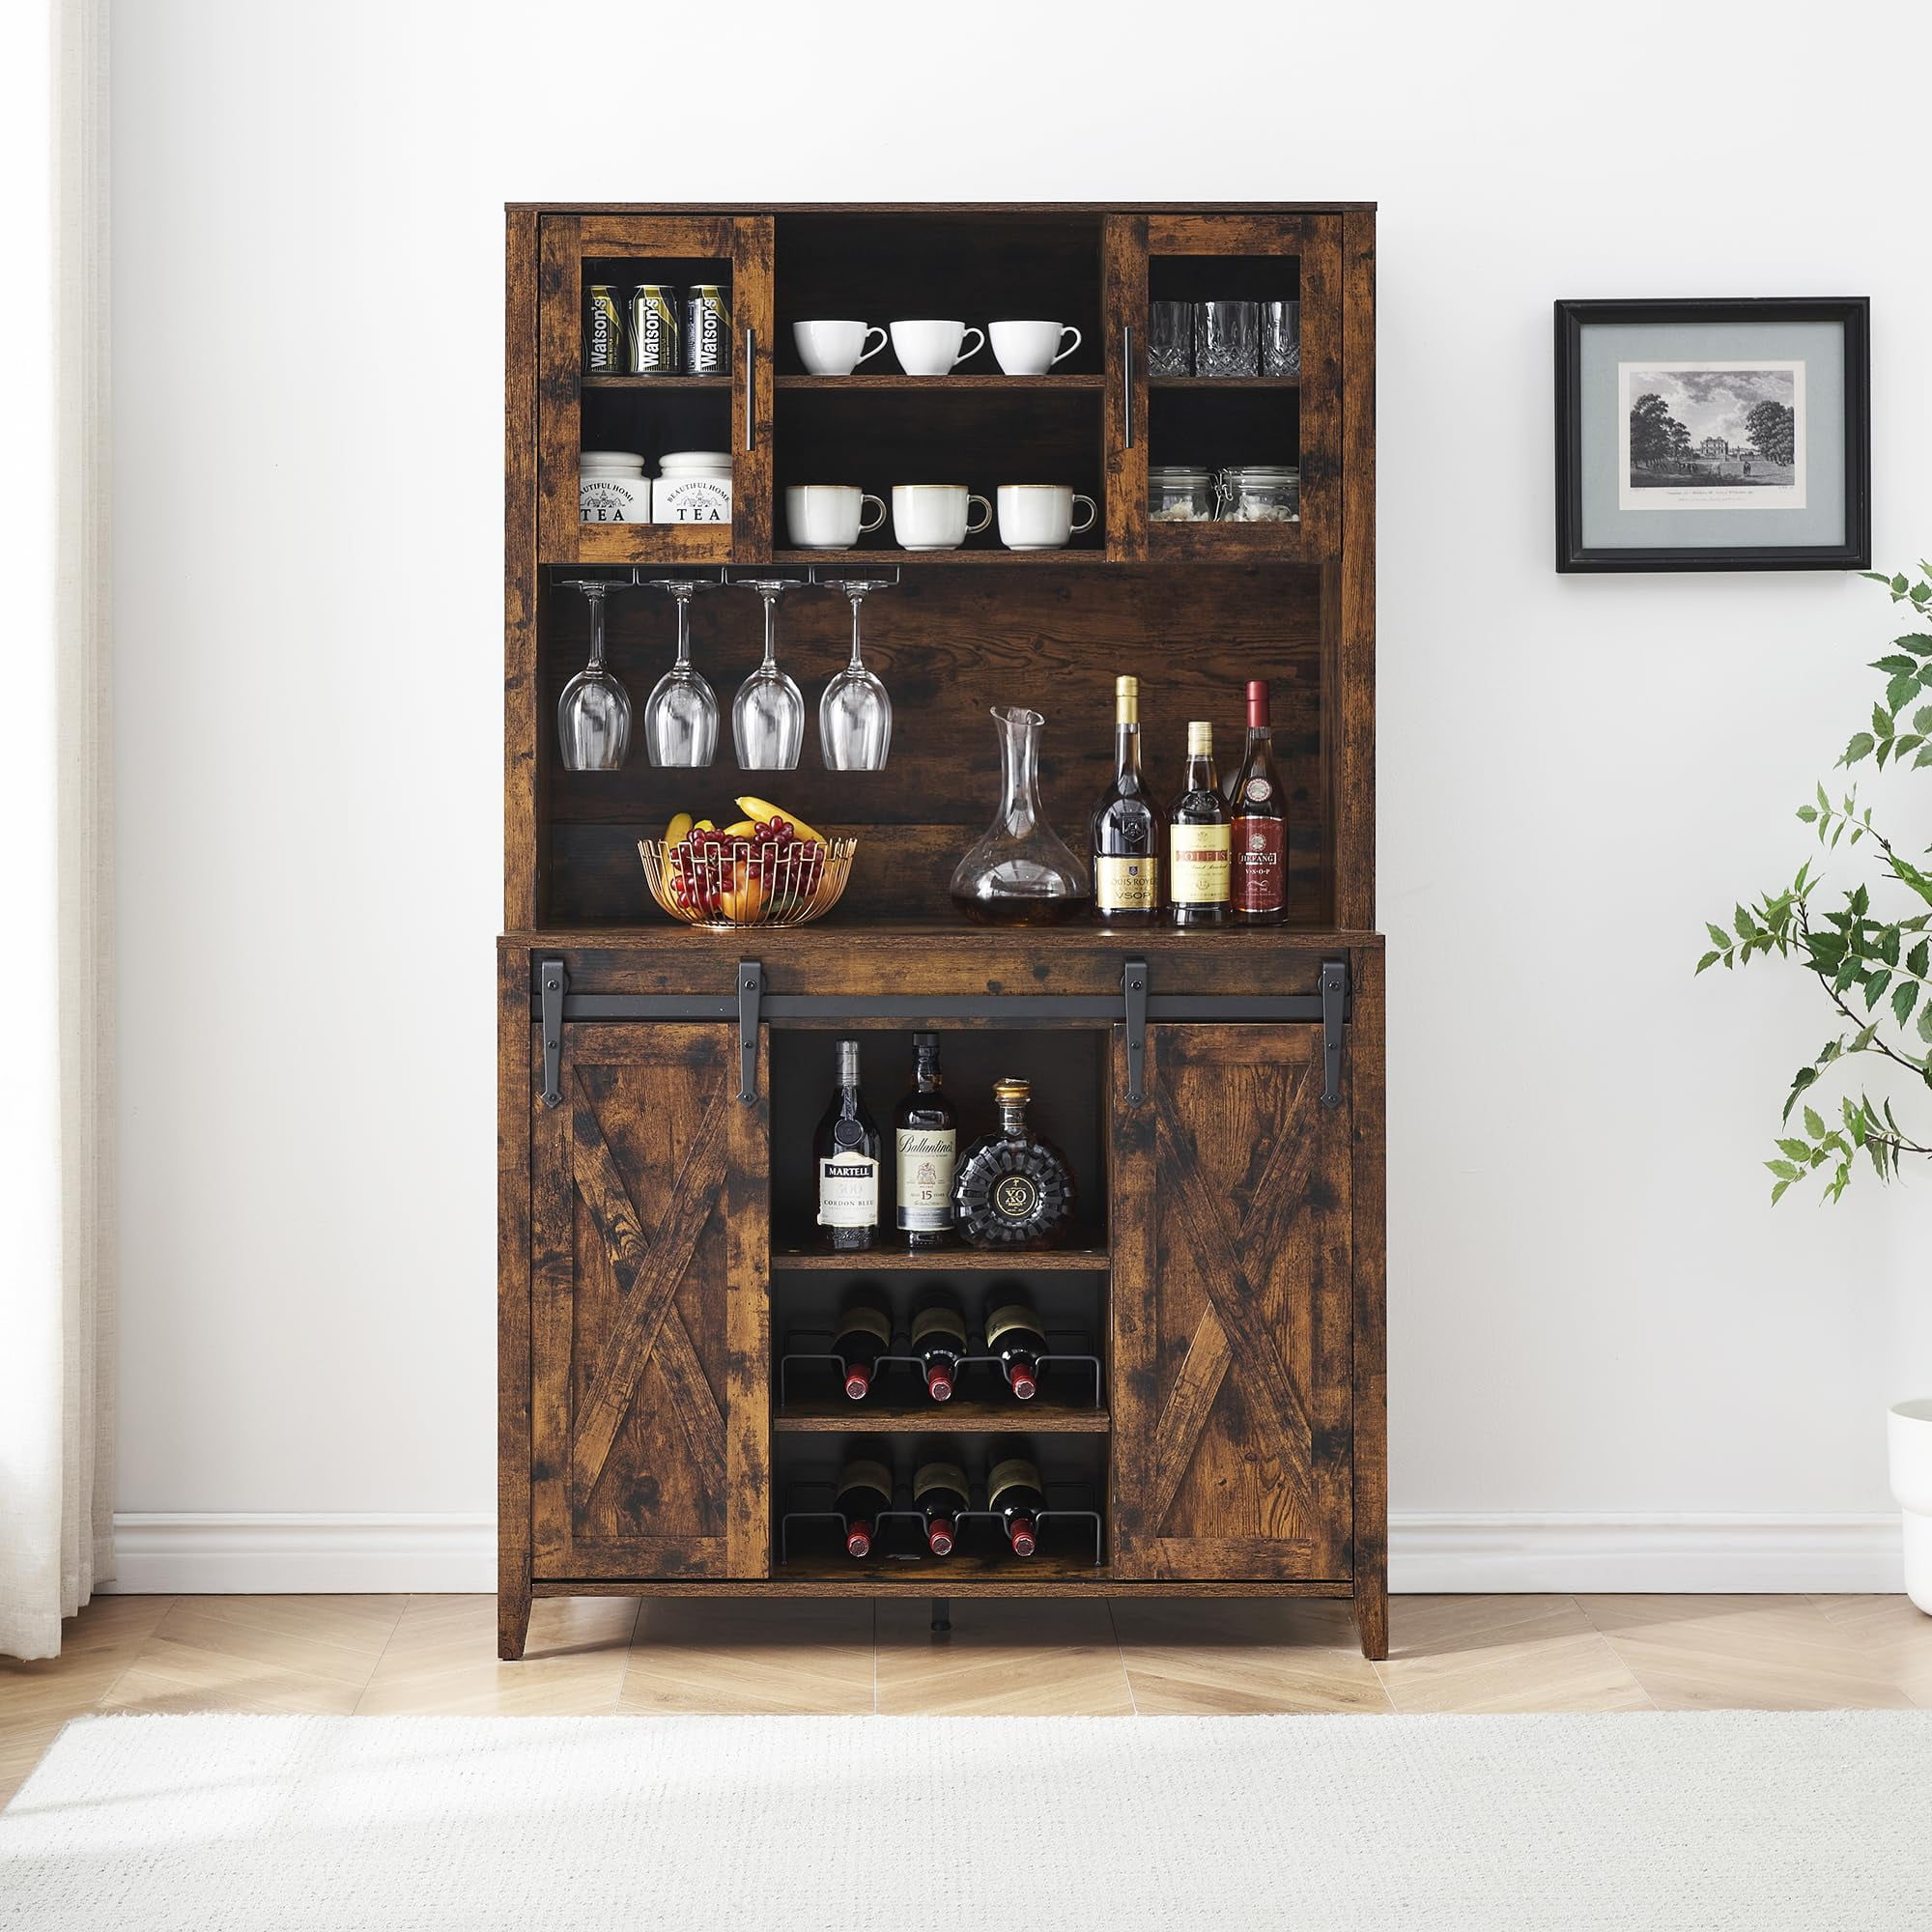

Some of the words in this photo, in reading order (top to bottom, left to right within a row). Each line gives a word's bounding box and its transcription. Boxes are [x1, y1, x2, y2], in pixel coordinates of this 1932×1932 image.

[591, 298, 608, 368] Watson's
[644, 298, 661, 368] Watson's
[700, 298, 718, 368] Watson's
[580, 482, 611, 497] AUTIFUL
[612, 484, 635, 503] HOME
[667, 482, 708, 503] BEAUTIFUL
[708, 484, 731, 503] HOME
[582, 508, 625, 522] TEA
[677, 508, 721, 521] TEA
[829, 1167, 869, 1176] MARTELL
[922, 1190, 933, 1200] 15
[1005, 1189, 1027, 1203] XO
